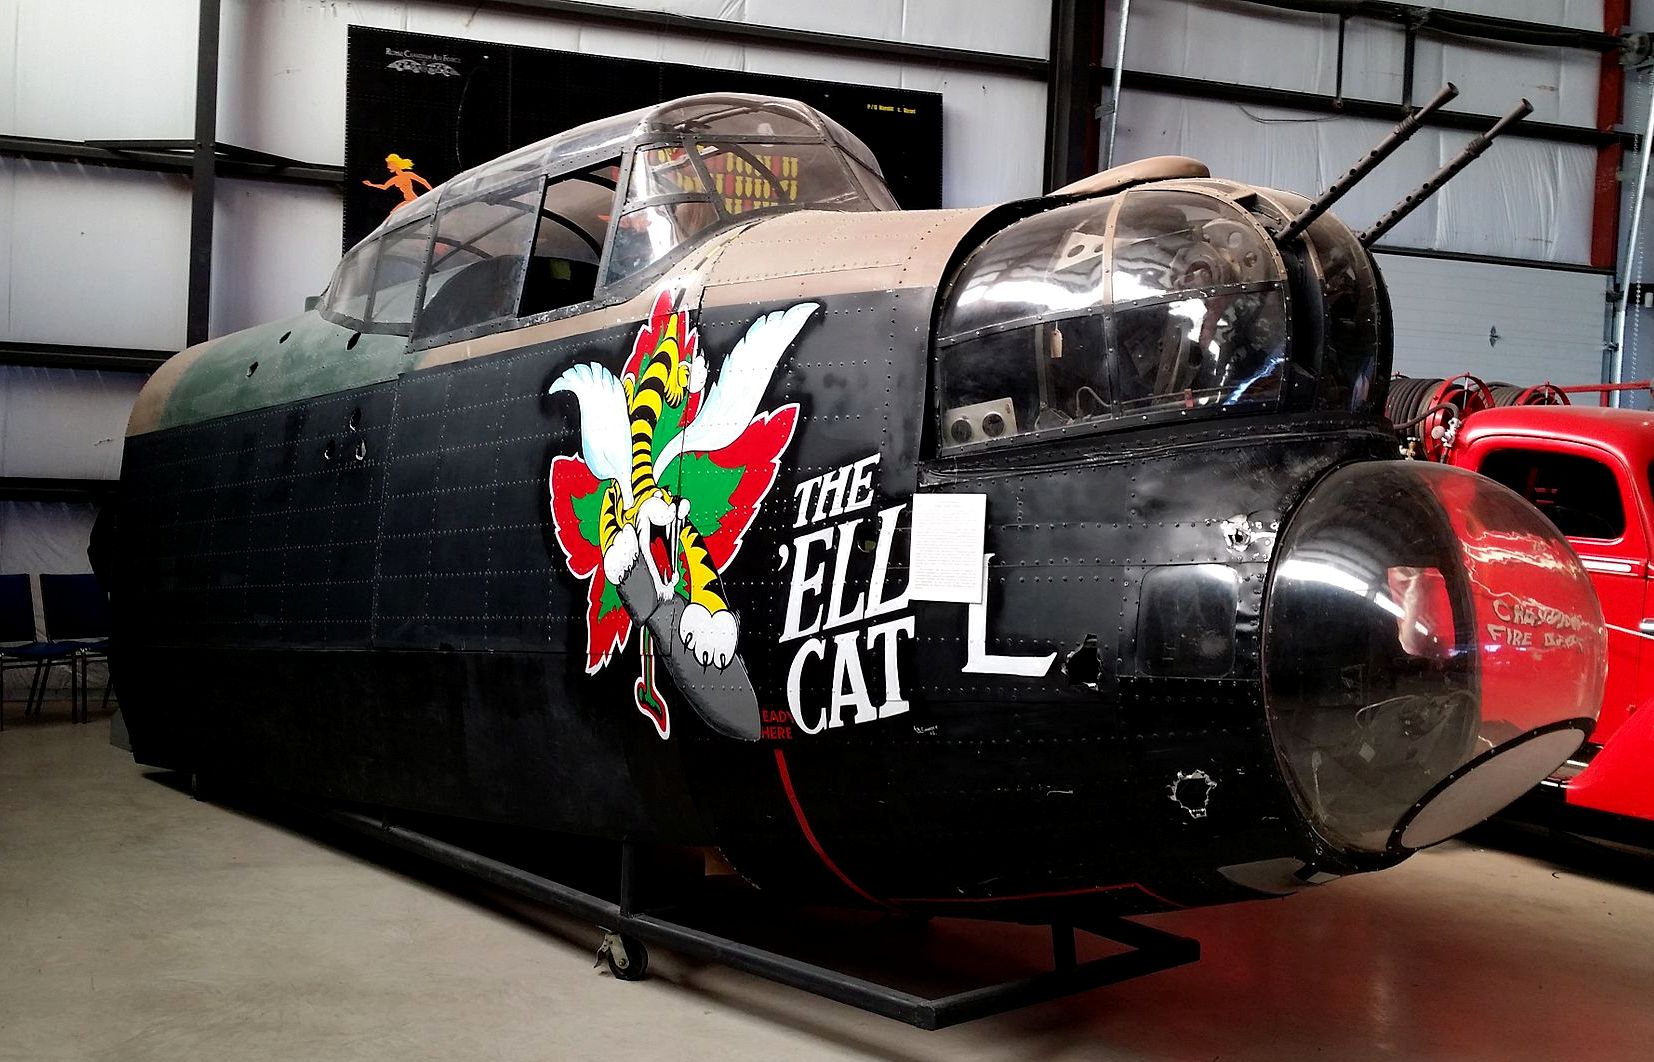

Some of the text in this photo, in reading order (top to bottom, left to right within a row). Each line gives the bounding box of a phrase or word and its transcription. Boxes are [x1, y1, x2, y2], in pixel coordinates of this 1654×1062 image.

[792, 453, 881, 528] THE
[778, 503, 910, 643] 'ELL
[1487, 623, 1532, 646] FIRE
[787, 615, 916, 735] CAT
[761, 725, 793, 740] HERE
